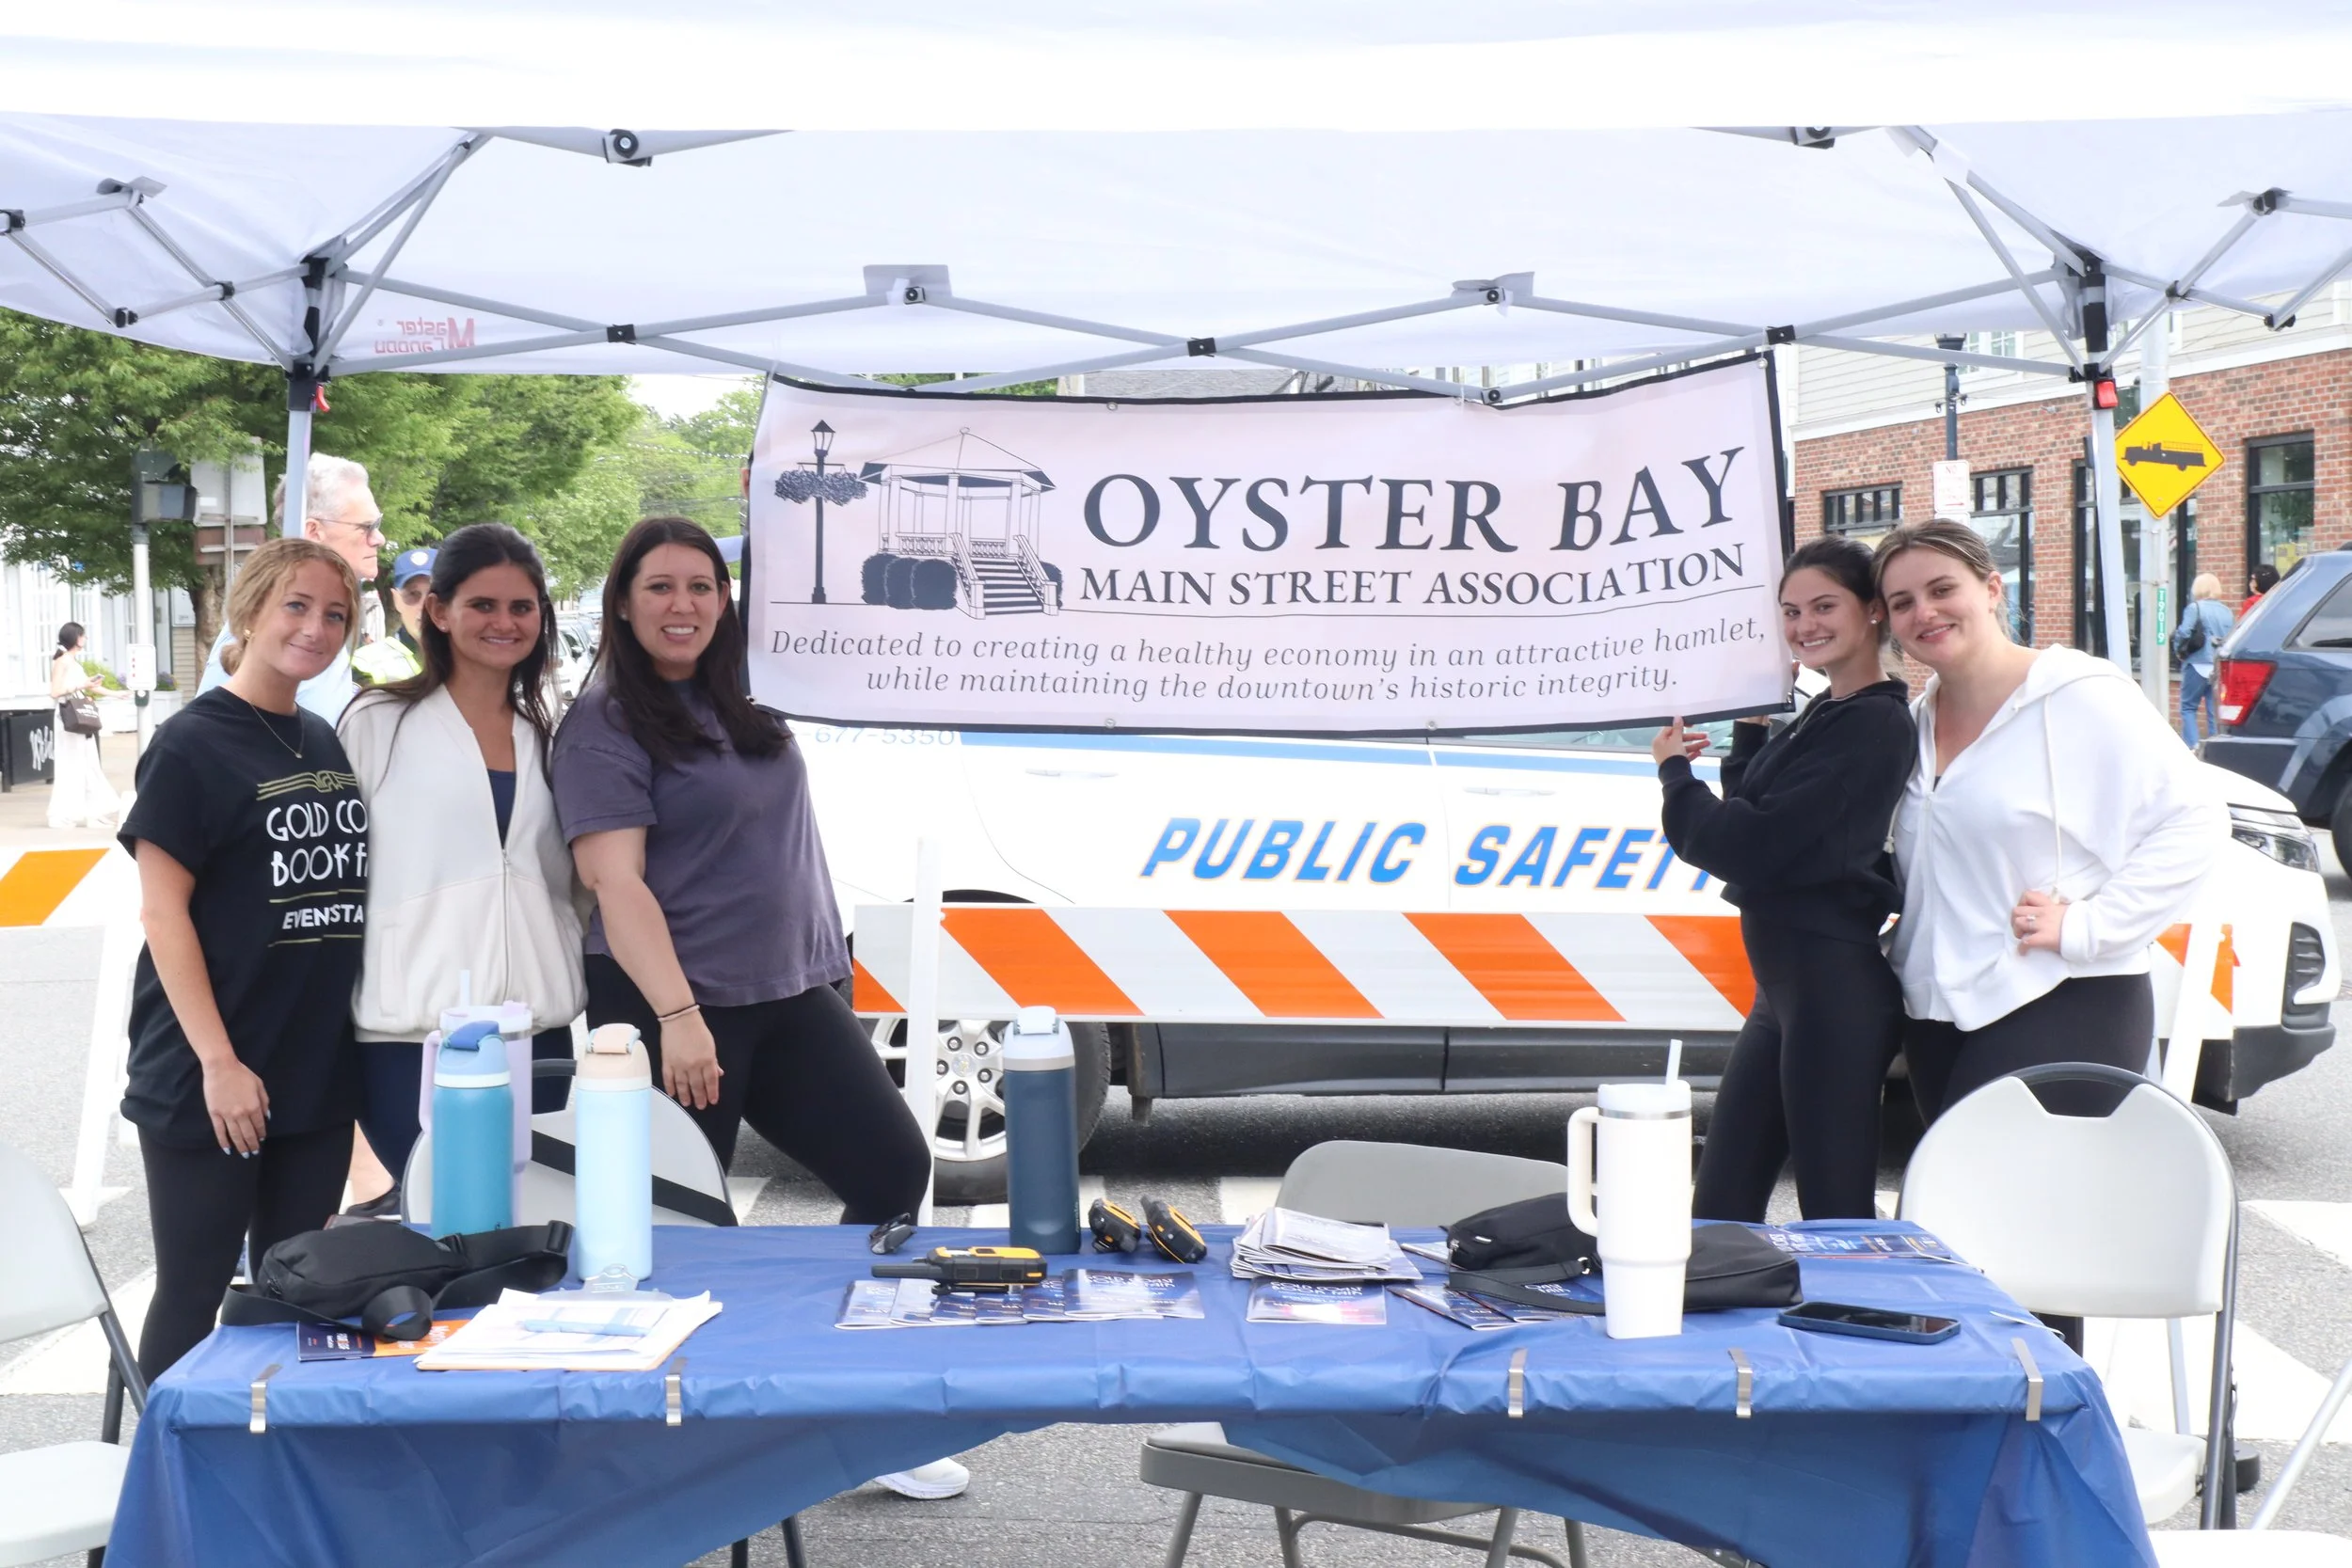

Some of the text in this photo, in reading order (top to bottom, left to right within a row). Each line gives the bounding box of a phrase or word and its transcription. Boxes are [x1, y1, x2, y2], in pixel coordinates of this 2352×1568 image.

[1084, 447, 1744, 553] OYSTER BAY
[1080, 543, 1744, 606] MAIN STREET ASSOCIATION
[771, 617, 1765, 673] Dedicated to creating a healthy economy in an attractive hamlet,
[867, 665, 1677, 703] while maintaining the downtown's historic integrity.
[265, 801, 329, 842] GOLD
[271, 842, 368, 887] BOOK F
[1137, 816, 1710, 893] PUBLIC SAFET
[282, 904, 364, 930] EVENSTA
